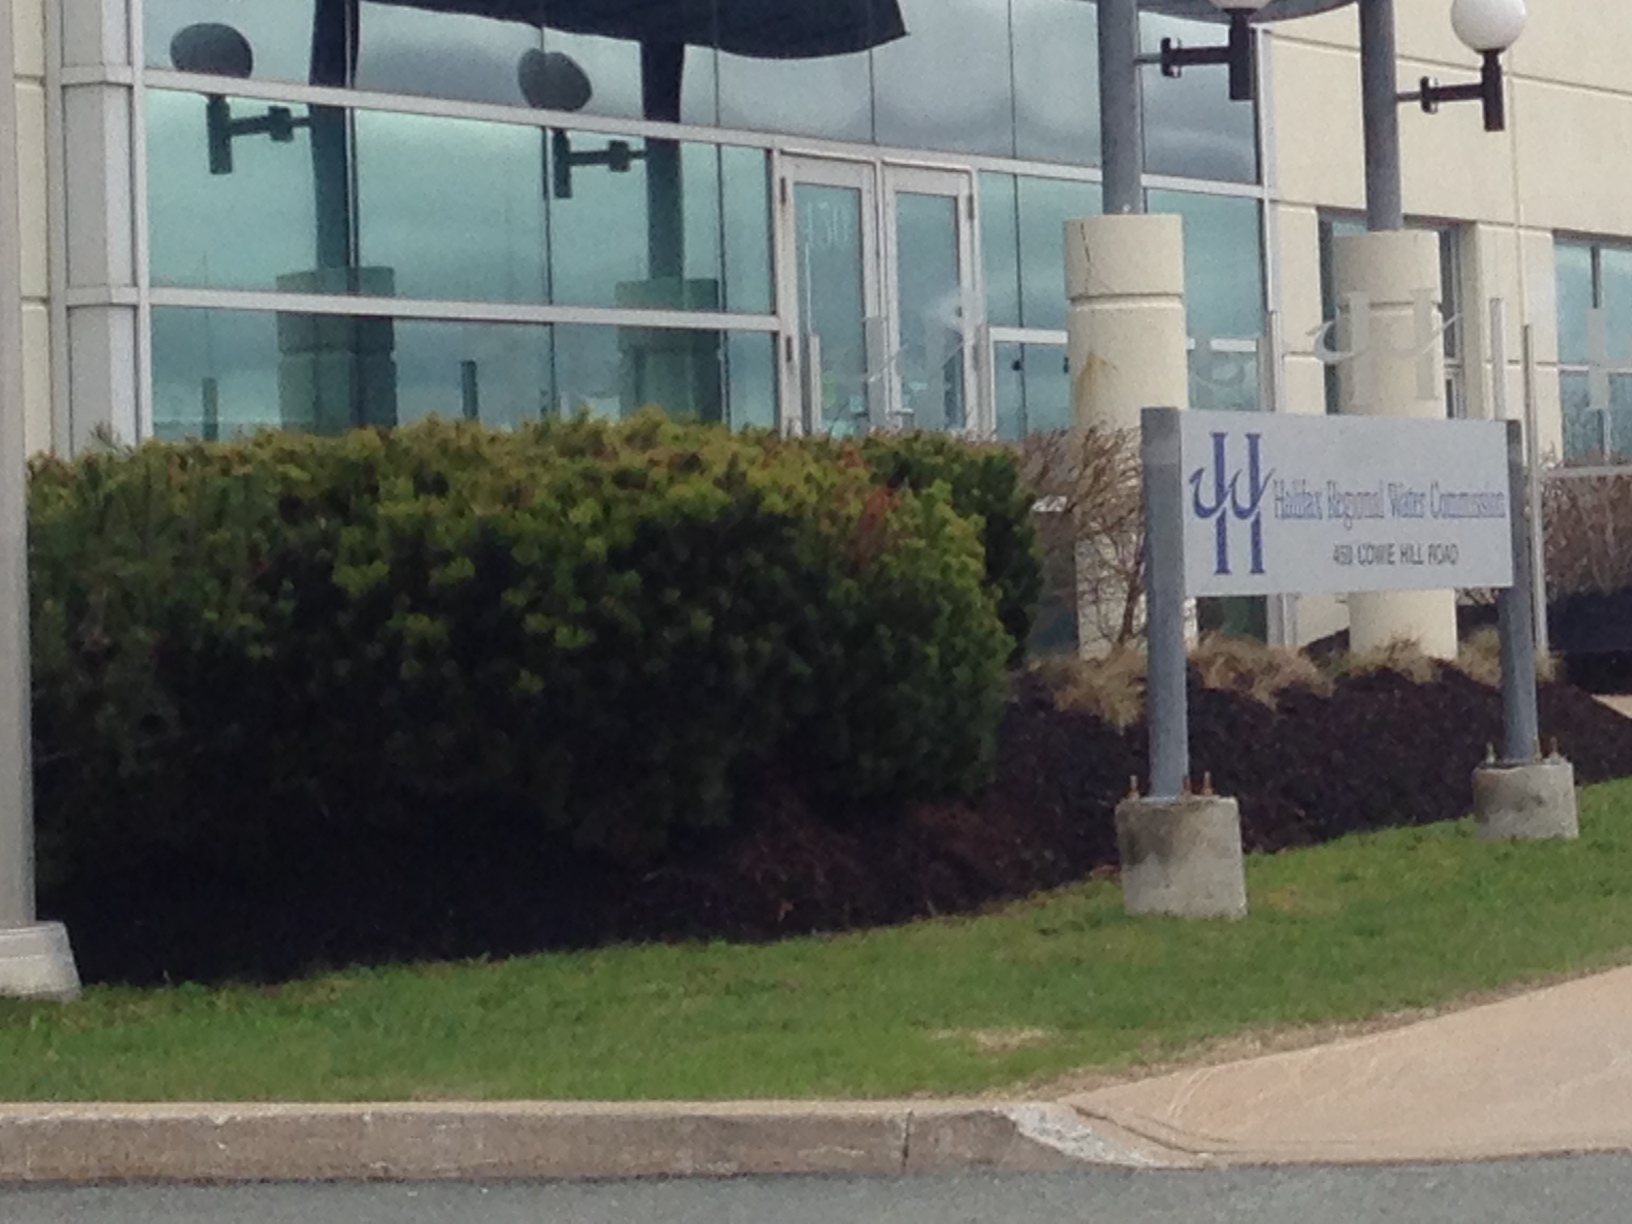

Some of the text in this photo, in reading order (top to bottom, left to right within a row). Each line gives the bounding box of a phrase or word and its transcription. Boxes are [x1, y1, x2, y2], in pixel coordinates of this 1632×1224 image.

[1273, 479, 1322, 520] Halifax
[1326, 480, 1384, 531] Regional
[1400, 543, 1424, 565] HILL
[1428, 543, 1459, 565] ROAD
